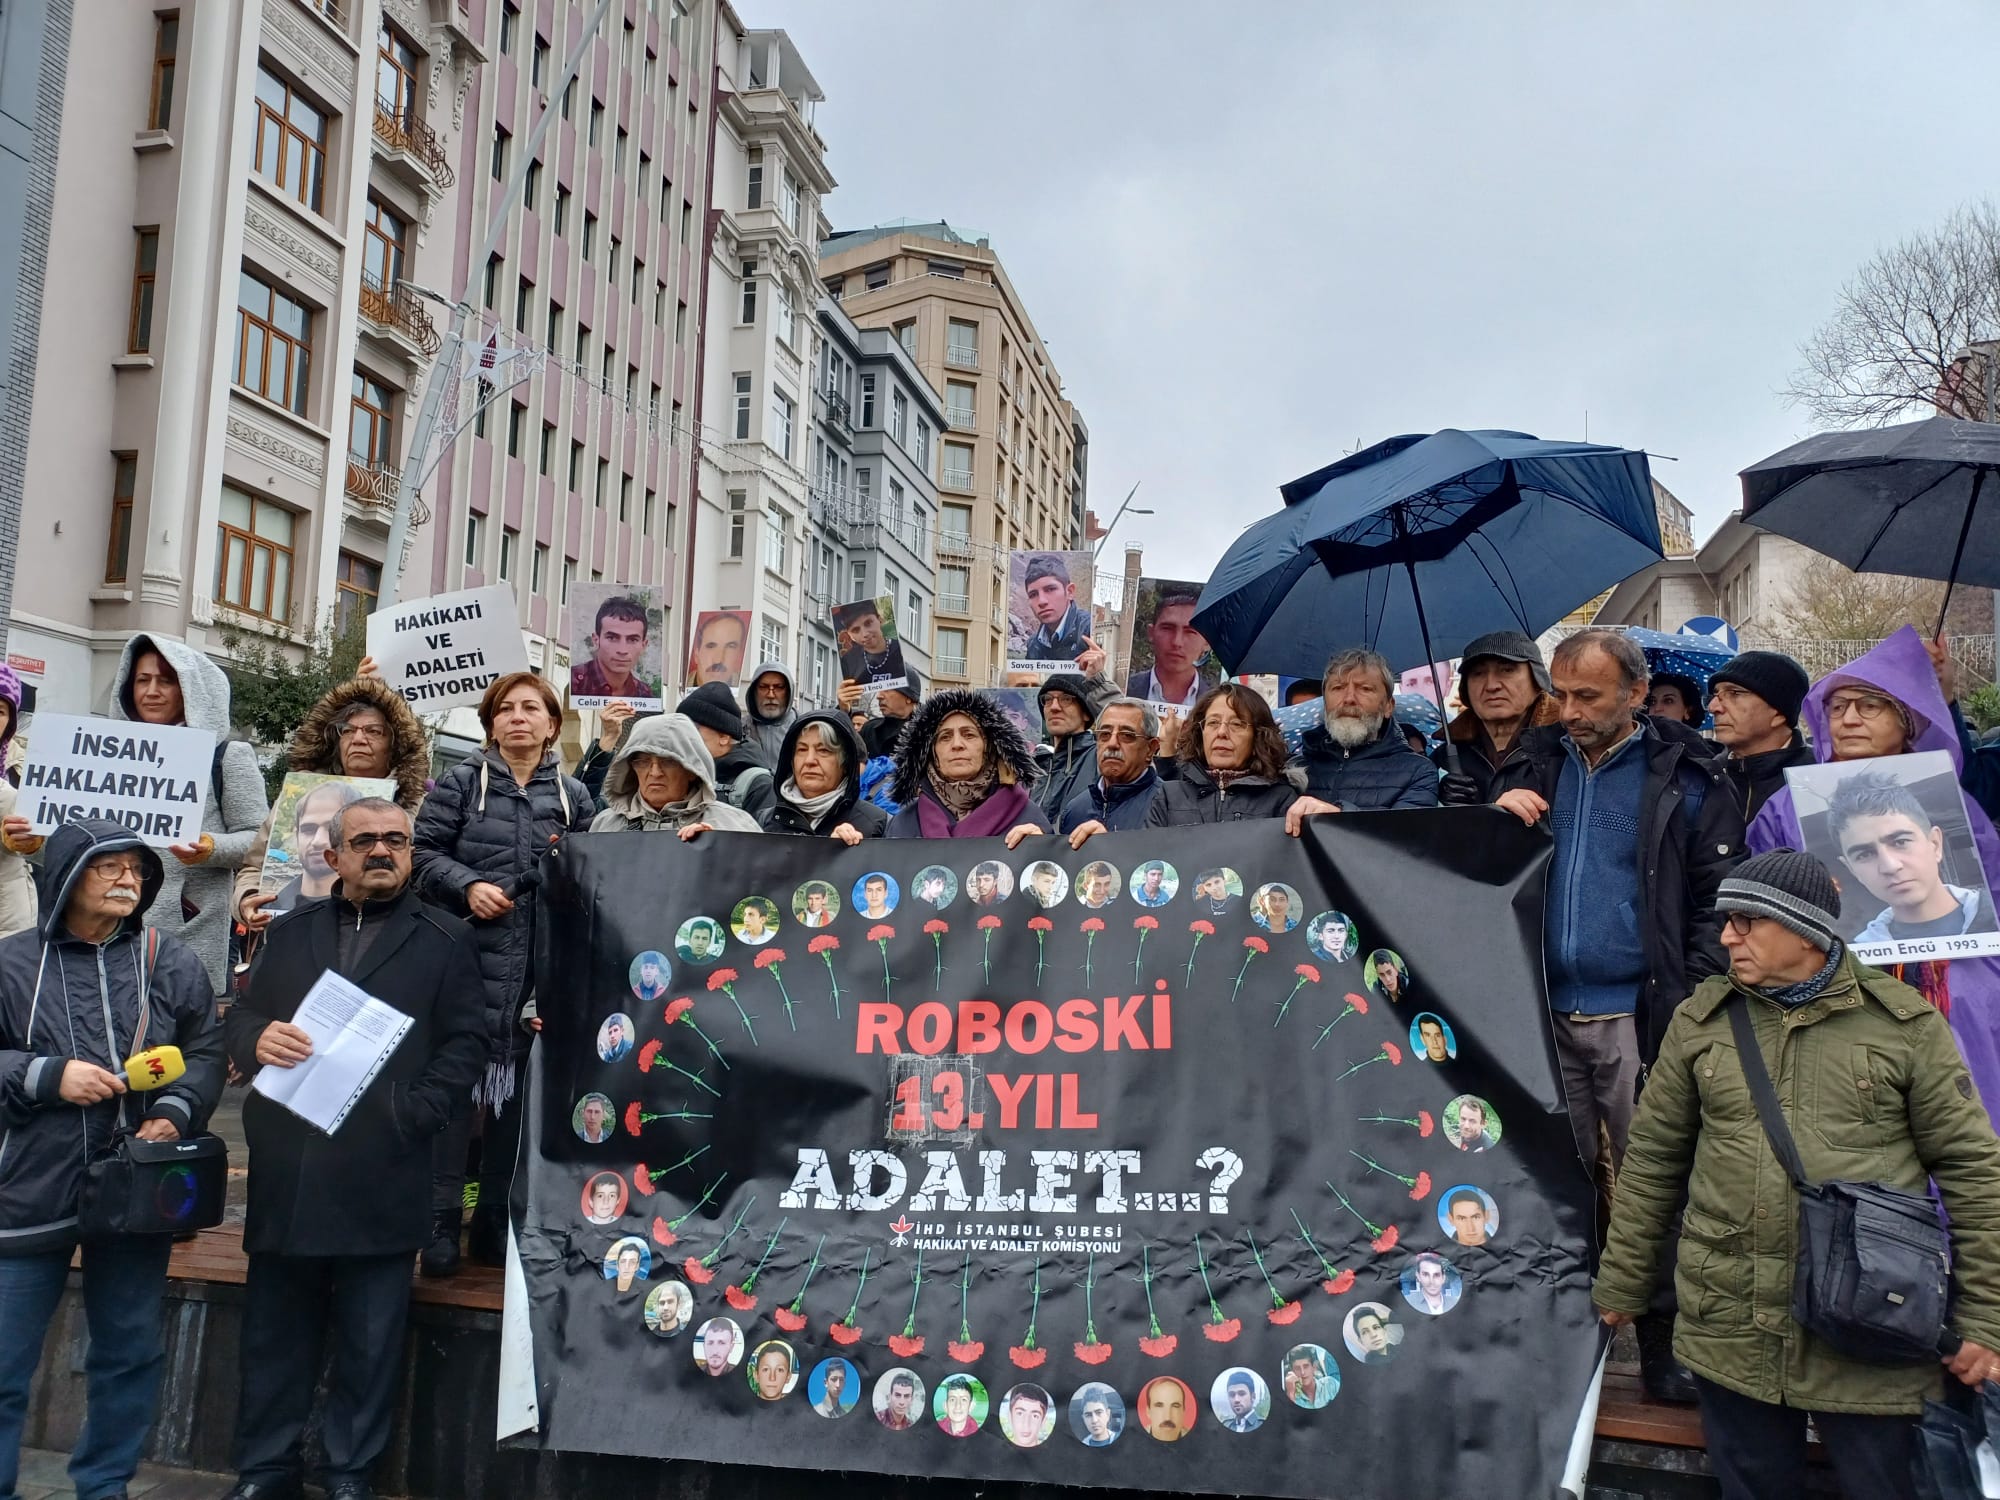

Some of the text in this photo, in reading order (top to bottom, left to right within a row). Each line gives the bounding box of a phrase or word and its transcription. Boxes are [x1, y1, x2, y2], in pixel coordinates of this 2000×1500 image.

[395, 600, 482, 632] HAKİKATİ
[425, 633, 453, 650] VE
[405, 648, 485, 678] ADALETİ
[1011, 661, 1034, 670] Savaş
[1036, 661, 1055, 669] Encü
[577, 698, 600, 707] Celal
[72, 727, 165, 768] İNSAN,
[25, 764, 198, 803] HAKLARIYLA
[1898, 941, 1936, 955] Encü
[1945, 939, 1979, 951] 1993
[855, 979, 1171, 1056] ROBOSKİ
[915, 1221, 1122, 1239] İHD İSTANBUL ŞUBESİ
[913, 1236, 1121, 1253] HAKİKAT VE ADALET KOMİSYONU
